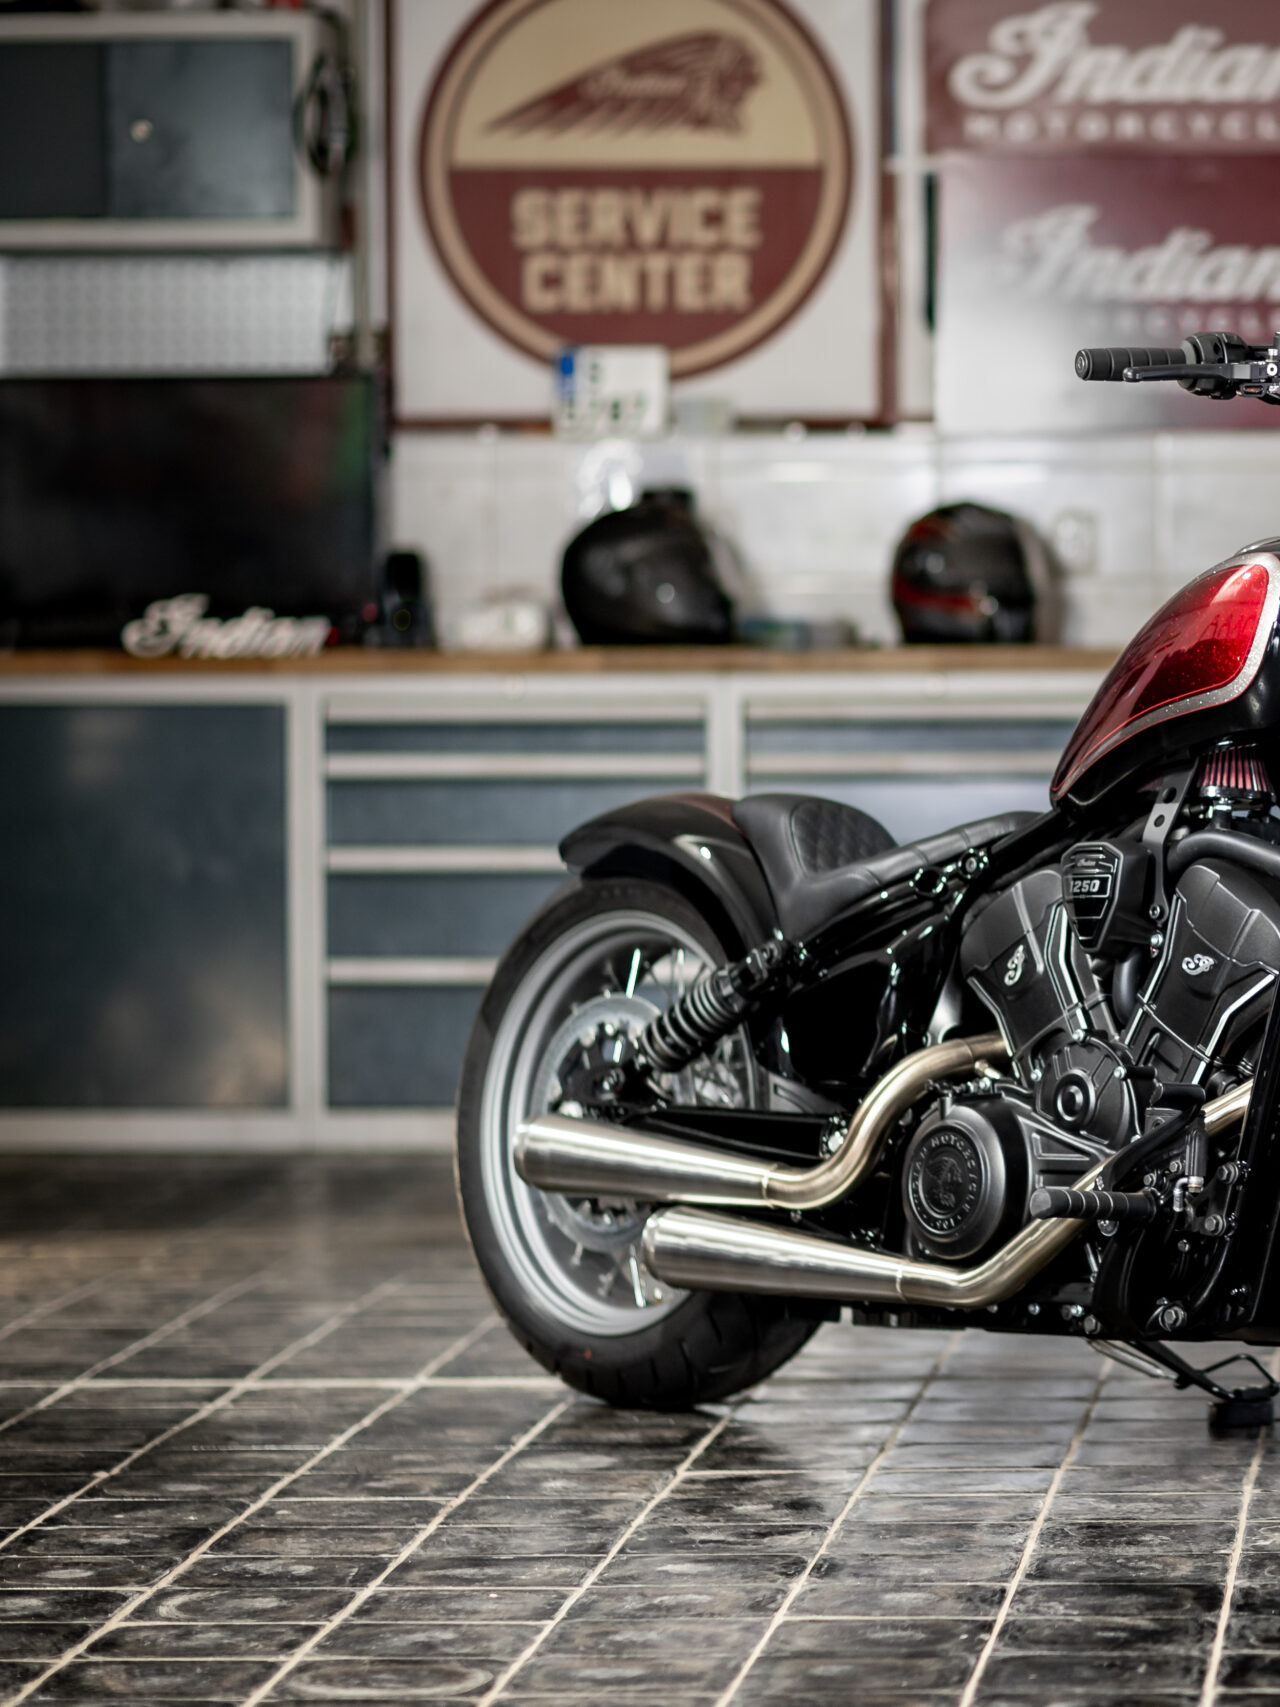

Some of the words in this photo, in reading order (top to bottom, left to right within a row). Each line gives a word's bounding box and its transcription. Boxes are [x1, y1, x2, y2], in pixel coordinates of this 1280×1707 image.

[513, 189, 761, 249] SERVICE
[522, 253, 751, 311] CENTER
[121, 593, 331, 659] Indian
[1070, 880, 1100, 892] 1250
